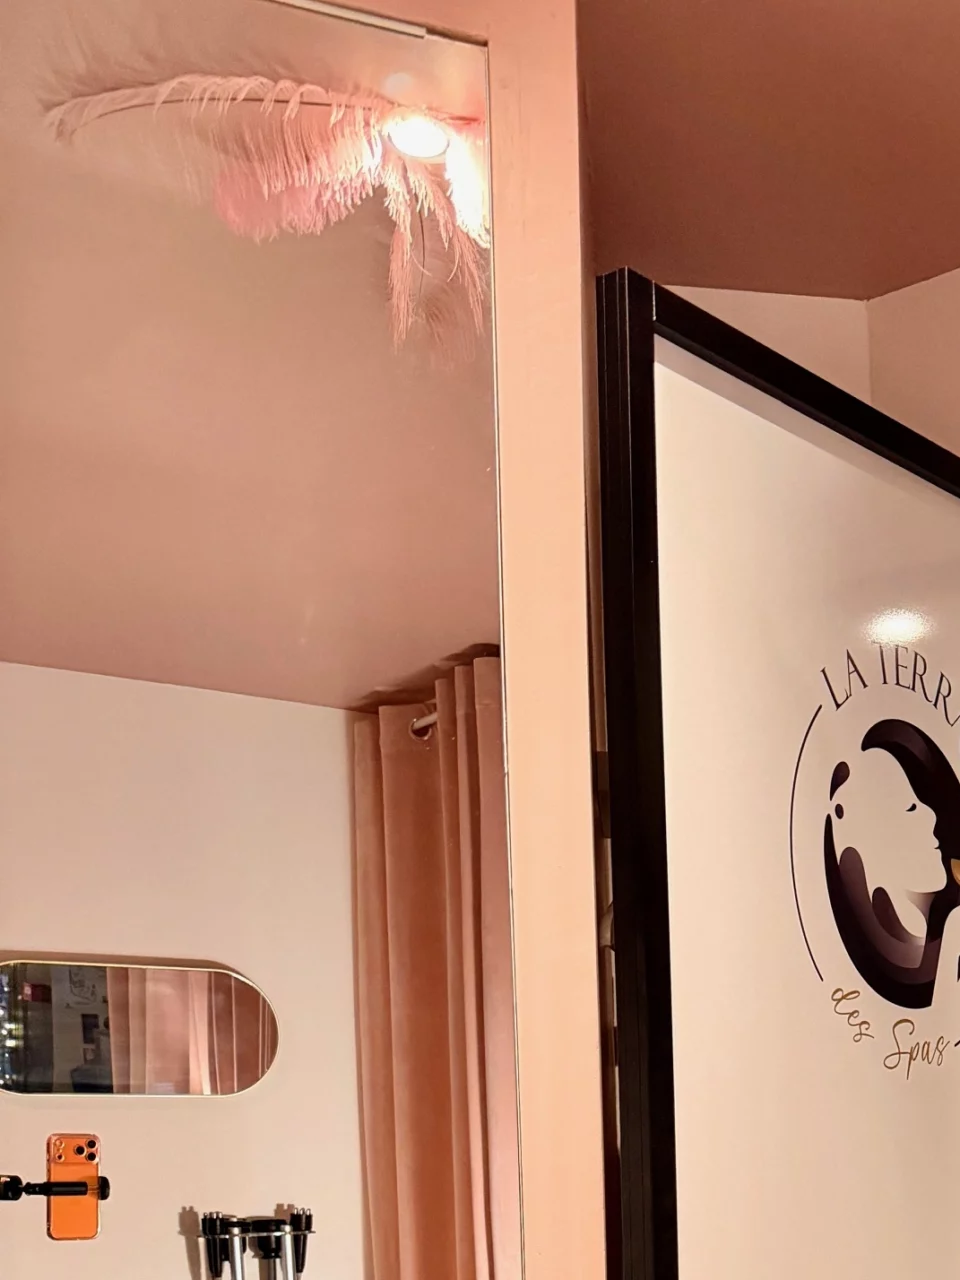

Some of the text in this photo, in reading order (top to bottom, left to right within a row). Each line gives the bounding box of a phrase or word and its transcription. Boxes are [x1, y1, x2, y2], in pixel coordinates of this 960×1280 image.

[820, 648, 868, 712] LA
[831, 987, 950, 1080] des Spas
